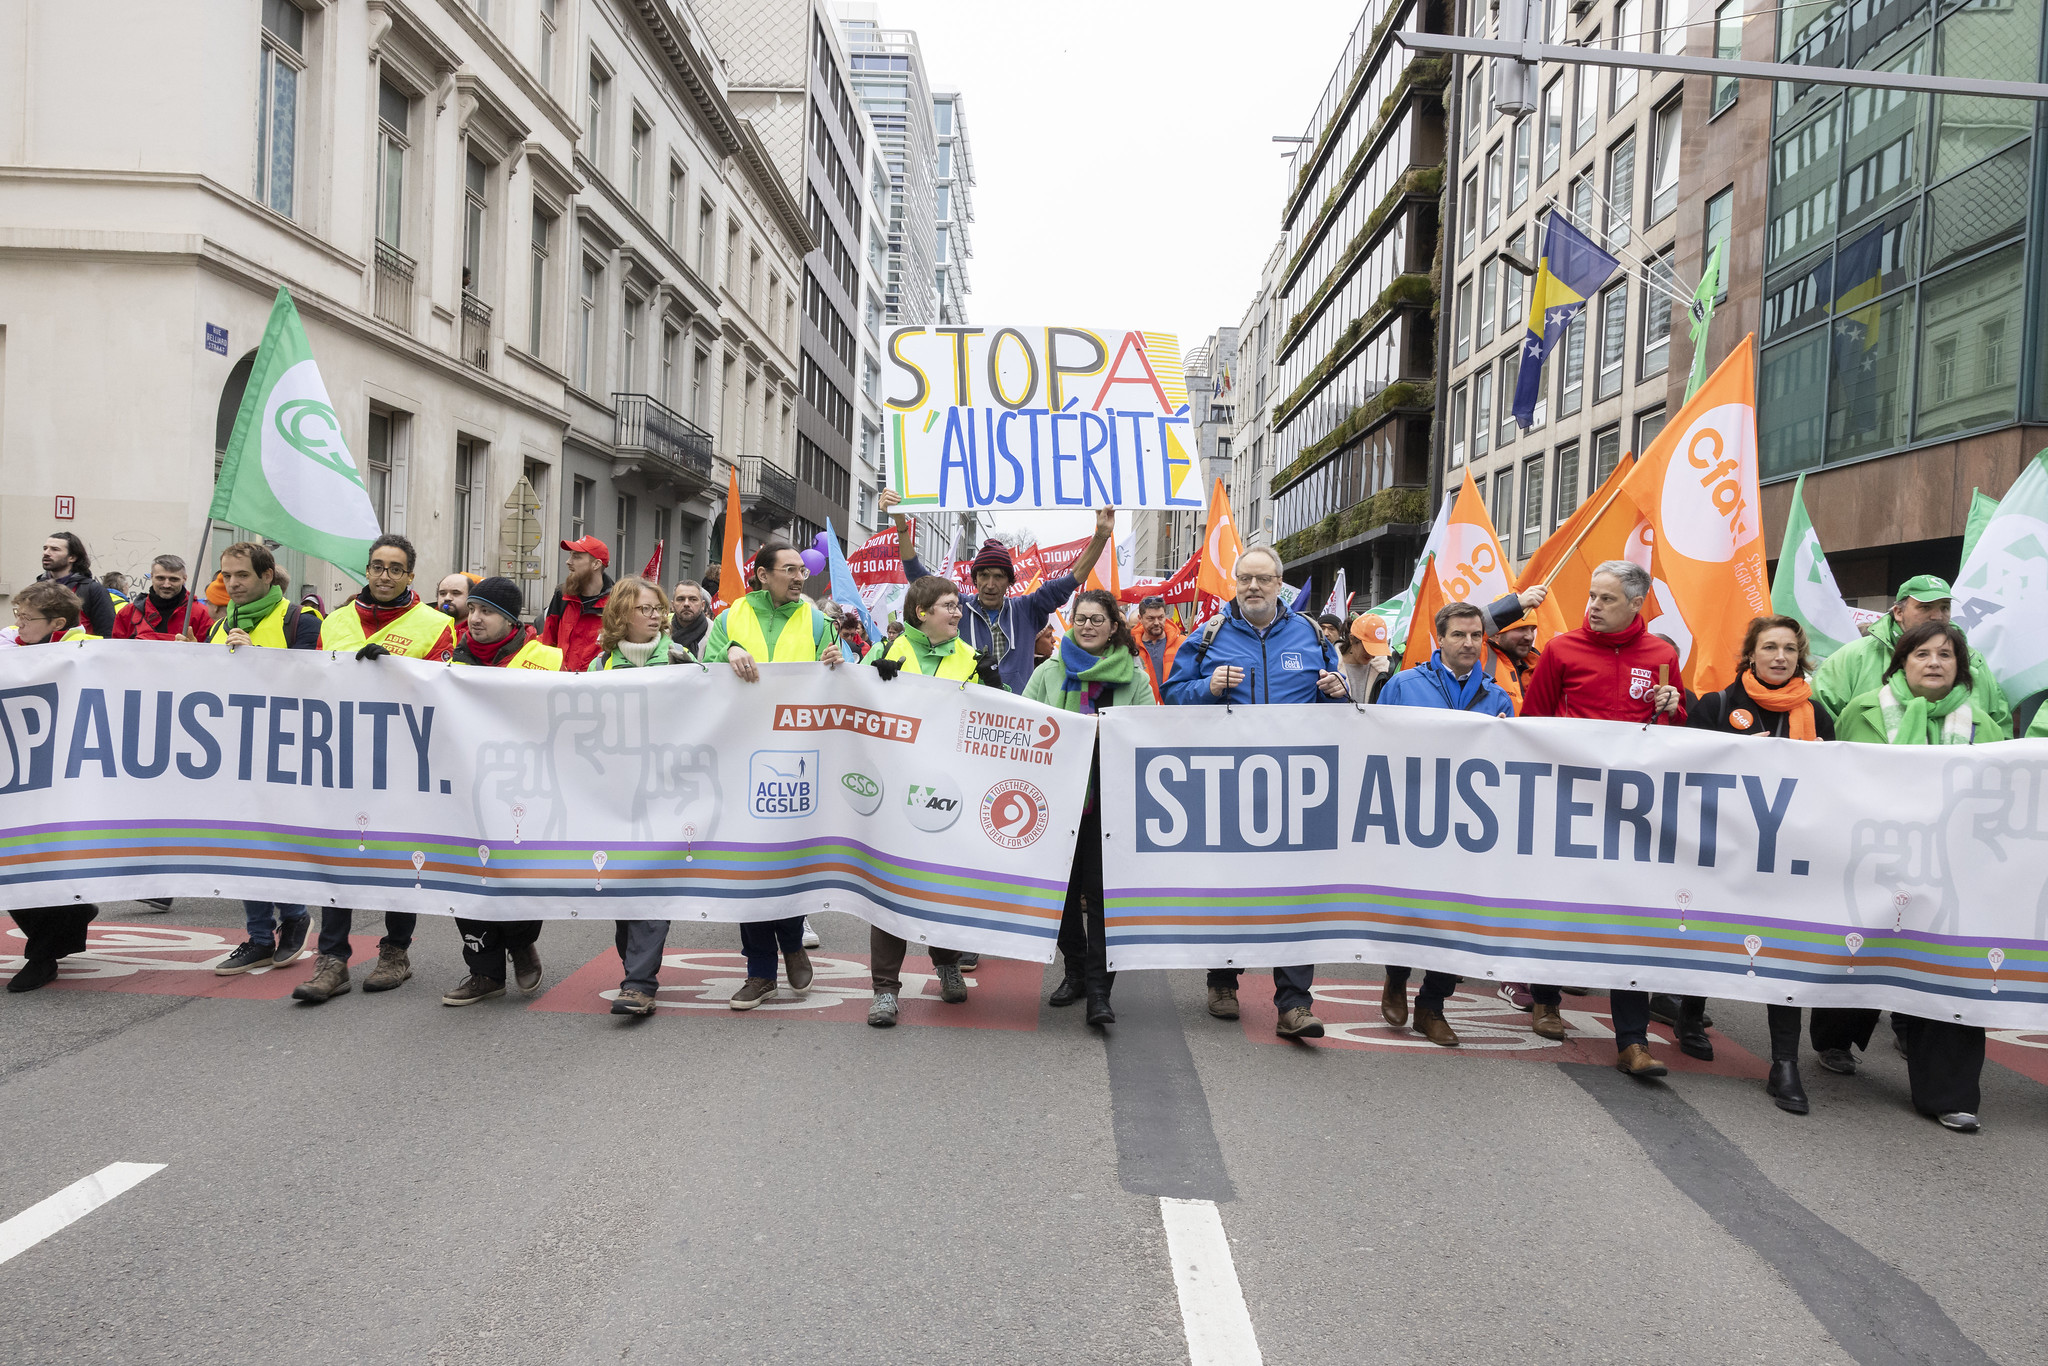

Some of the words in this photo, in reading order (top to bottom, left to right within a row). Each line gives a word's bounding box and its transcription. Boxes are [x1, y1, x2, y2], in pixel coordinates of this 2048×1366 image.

[213, 327, 222, 336] RUE
[884, 326, 1109, 413] STOP
[1734, 562, 1752, 586] AGIR
[1743, 584, 1764, 613] POUR
[387, 634, 411, 646] ABVV
[1632, 669, 1650, 677] ABVV
[779, 708, 913, 739] ABVV-FGTB
[968, 711, 1034, 731] SYNDICAT
[64, 689, 452, 794] AUSTERITY.
[964, 740, 1007, 759] TRADE
[1010, 747, 1053, 765] UNION
[756, 782, 810, 797] ACLVB
[846, 775, 875, 796] CSC
[990, 781, 1030, 797] TOGETHER
[1028, 788, 1043, 803] FOR
[756, 797, 810, 813] CGSLB
[925, 796, 958, 811] ACV
[1143, 754, 1330, 847] STOP
[1352, 755, 1809, 875] AUSTERITY.
[982, 812, 993, 830] FAIR
[988, 829, 1006, 845] DEAL
[1007, 838, 1022, 847] FOR
[1022, 812, 1047, 844] WORKERS
